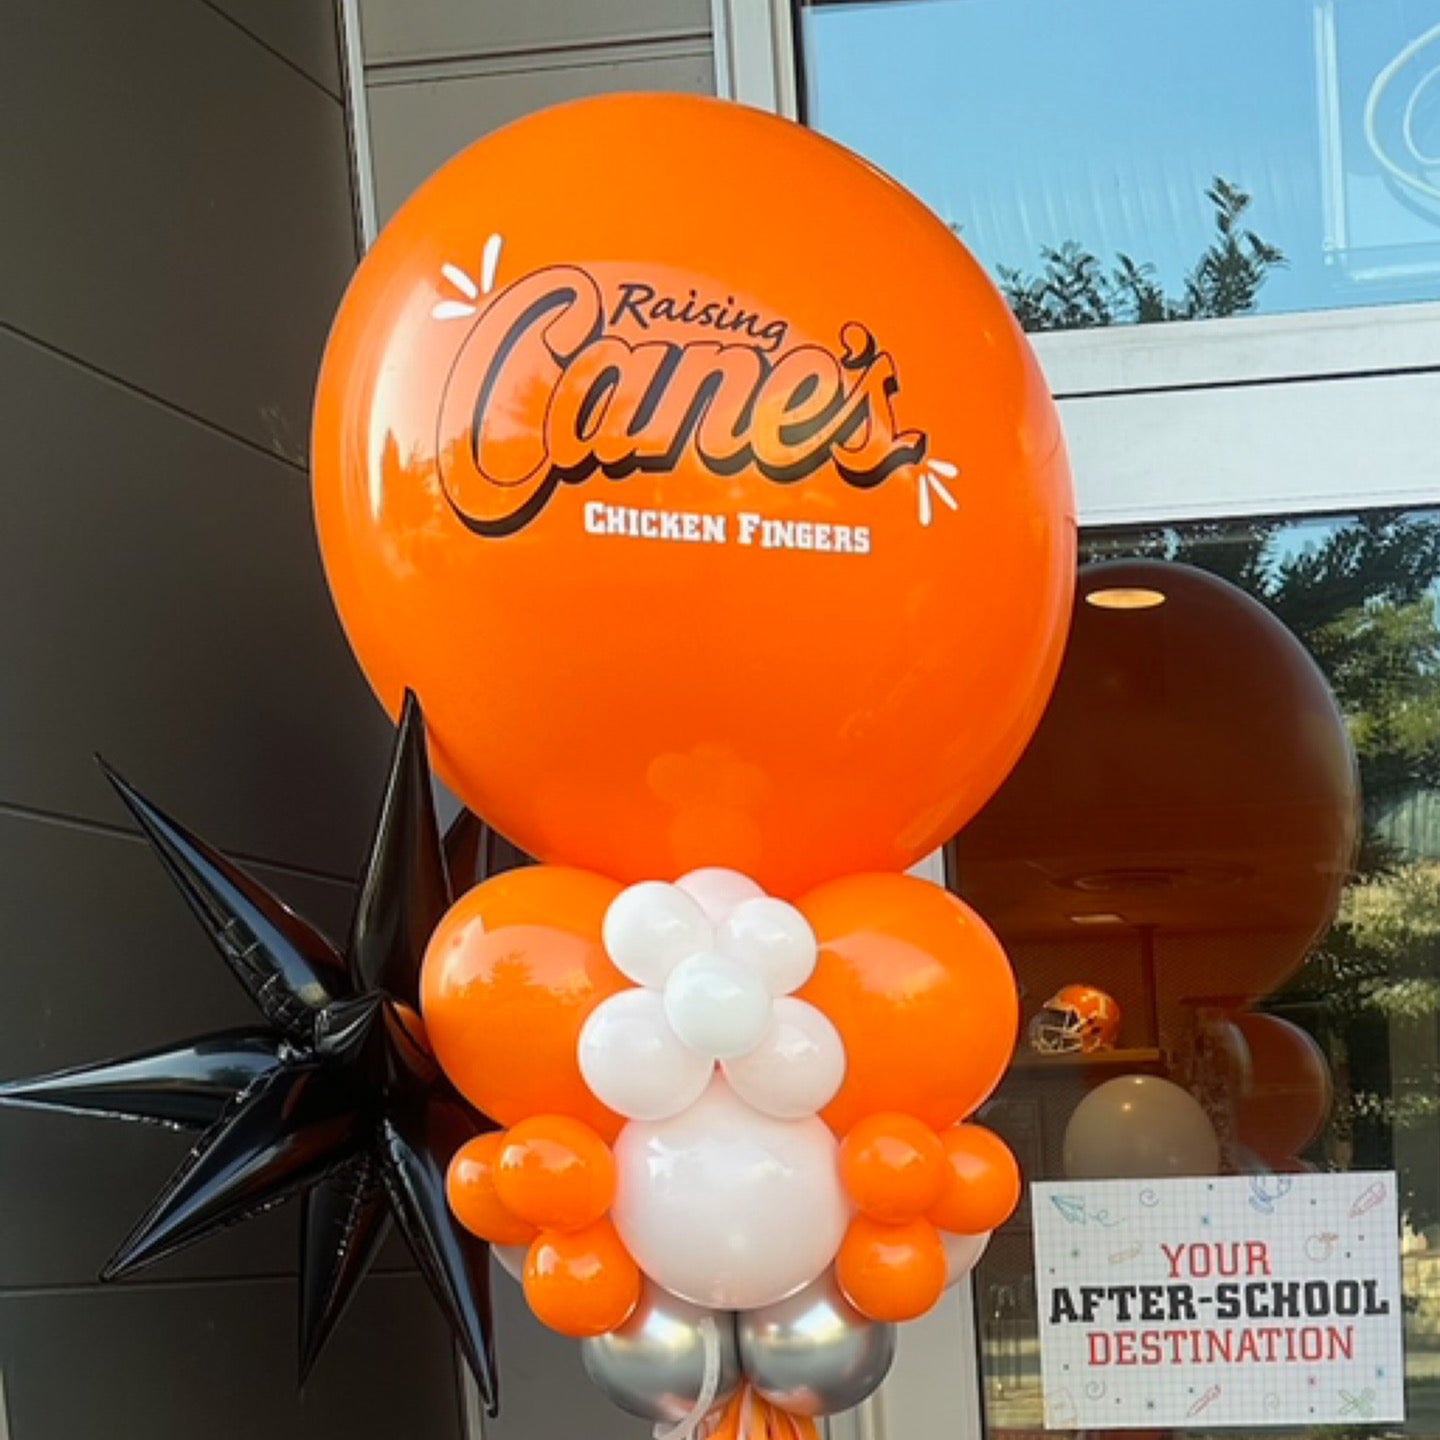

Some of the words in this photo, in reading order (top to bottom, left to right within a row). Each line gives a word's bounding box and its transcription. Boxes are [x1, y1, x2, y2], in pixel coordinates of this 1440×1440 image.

[609, 283, 788, 352] Raising
[436, 264, 927, 538] Cane's
[1161, 1241, 1271, 1278] YOUR
[1049, 1280, 1390, 1323] AFTER-SCHOOL
[1086, 1325, 1355, 1366] DESTINATION
